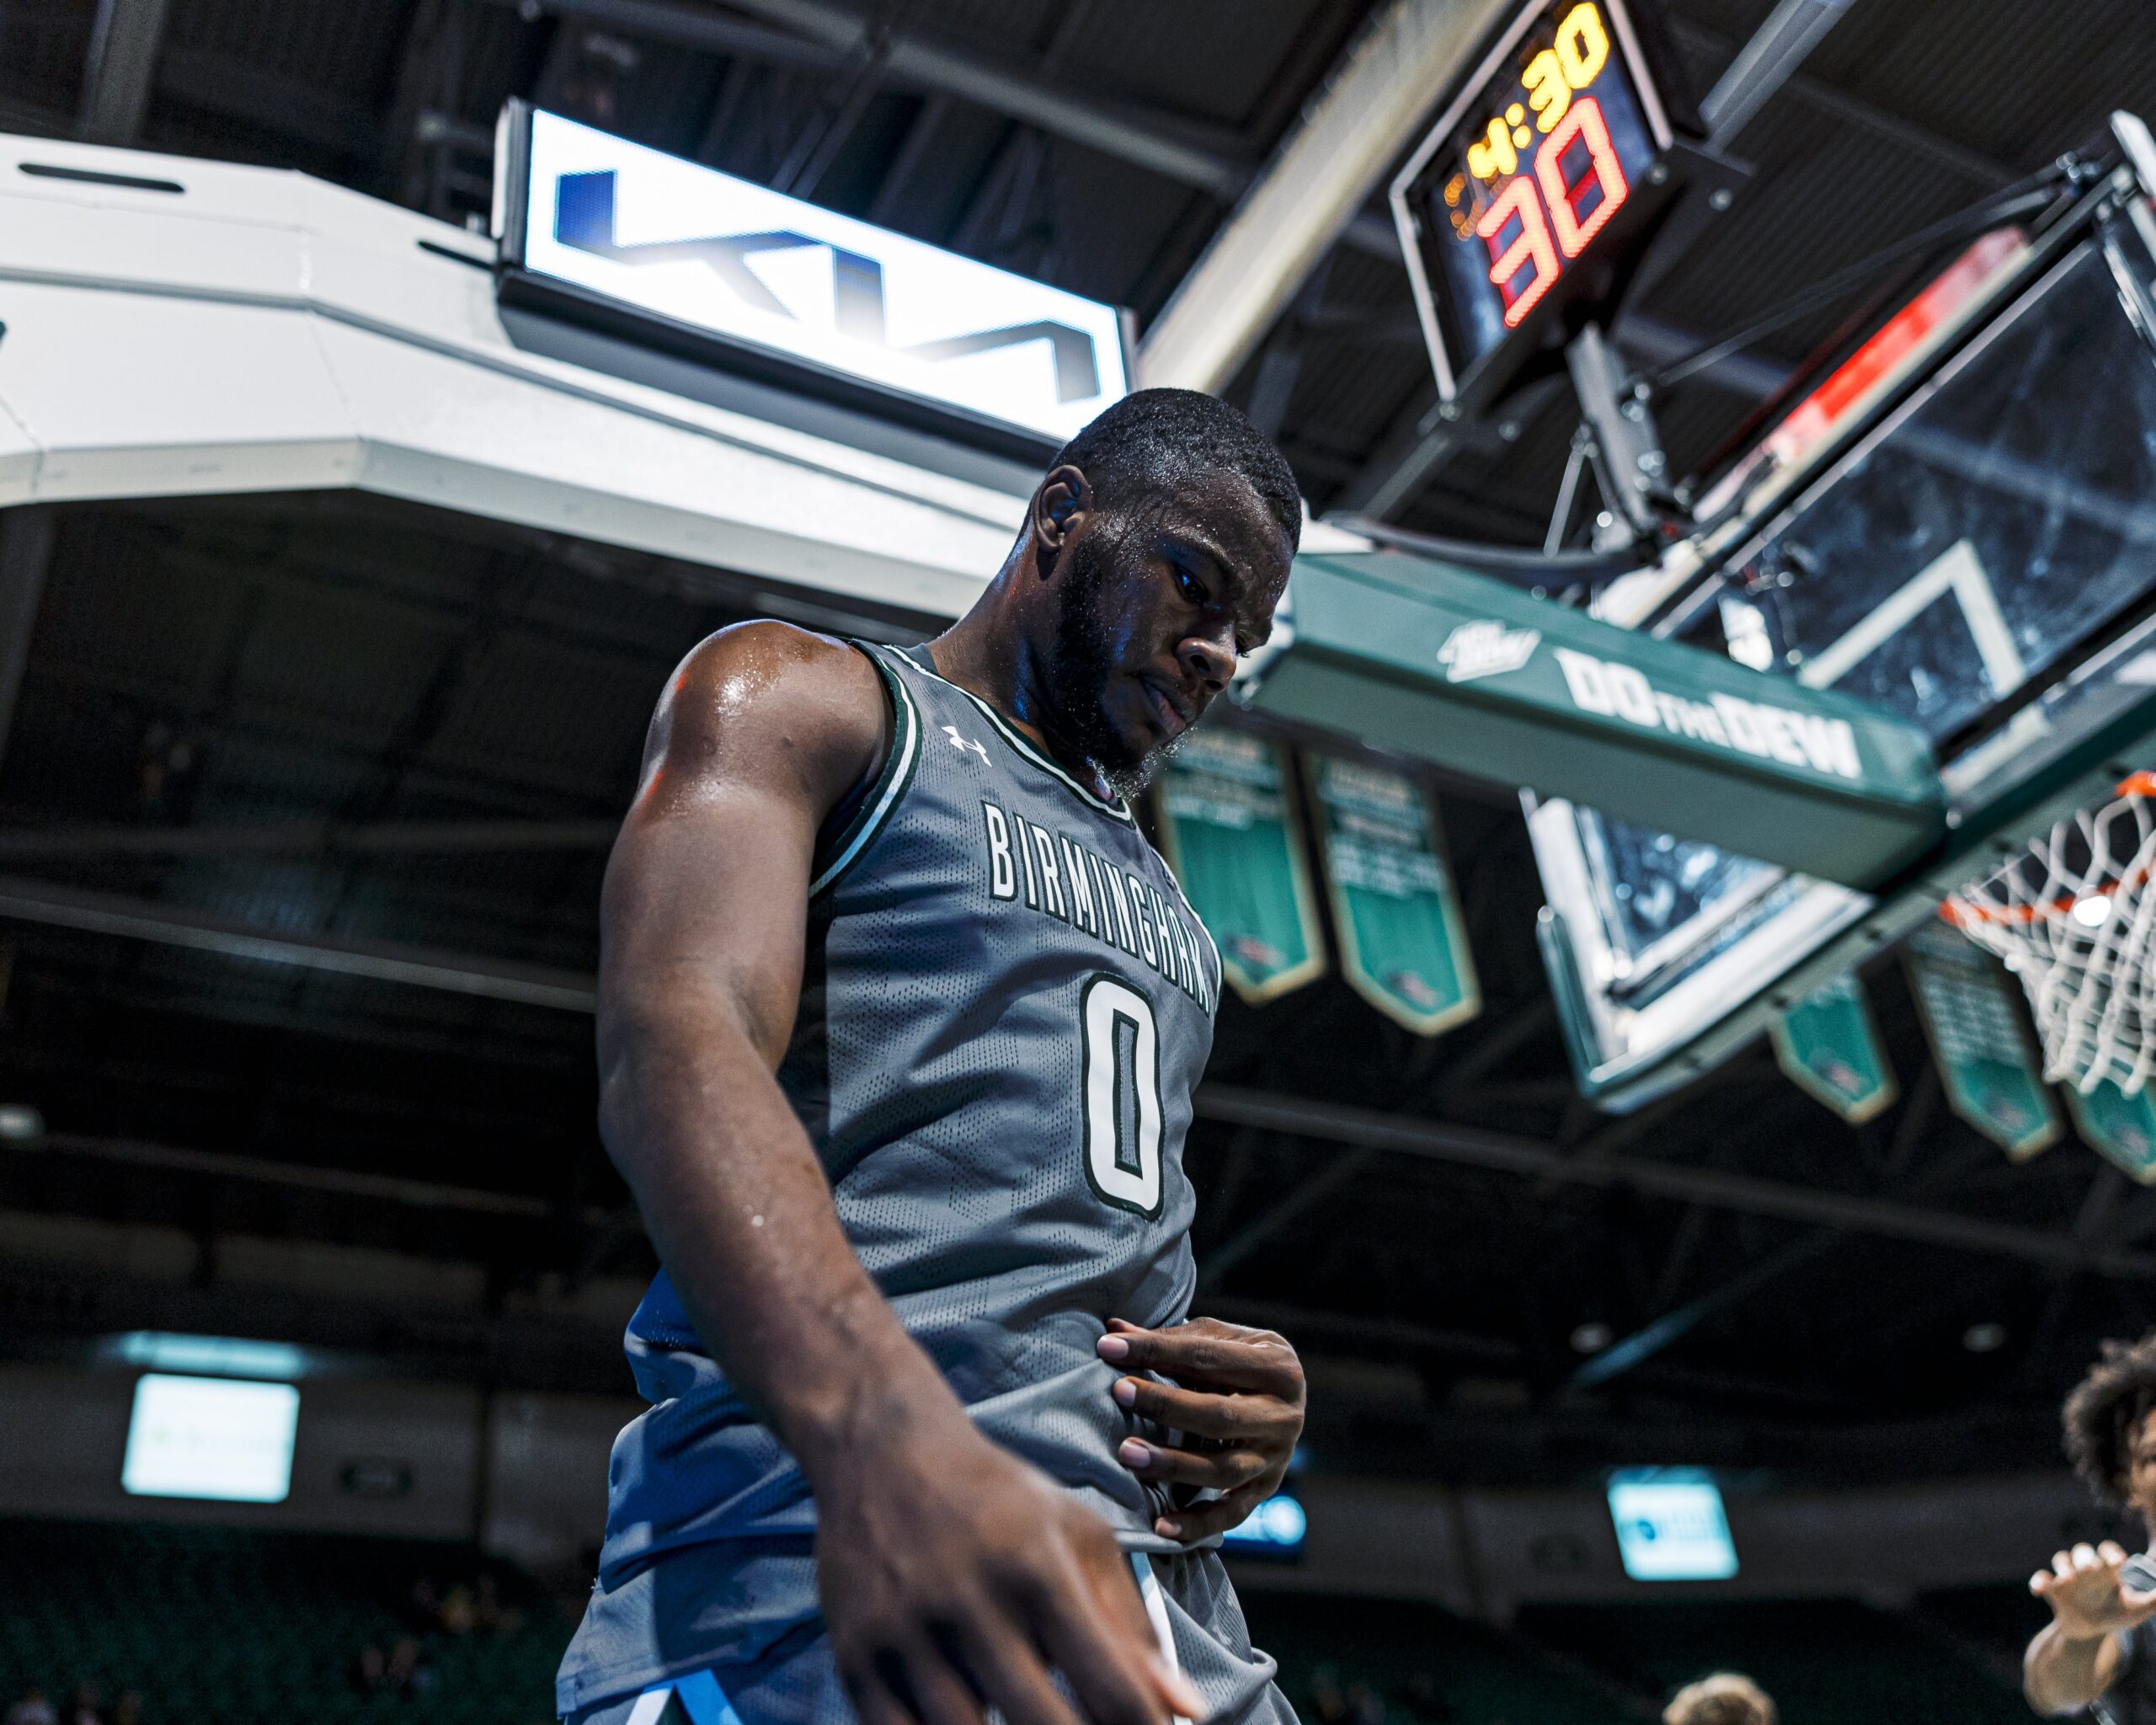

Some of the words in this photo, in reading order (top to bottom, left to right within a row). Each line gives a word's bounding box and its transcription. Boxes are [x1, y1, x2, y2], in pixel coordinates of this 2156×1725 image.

[1467, 2, 1609, 178] 4:30
[1476, 96, 1630, 328] 30
[1553, 646, 1661, 727] DO
[1653, 690, 1732, 748] THE
[1707, 691, 1864, 779] DEW
[981, 801, 1210, 1017] BIRMINGHAM
[1081, 971, 1166, 1222] 0
